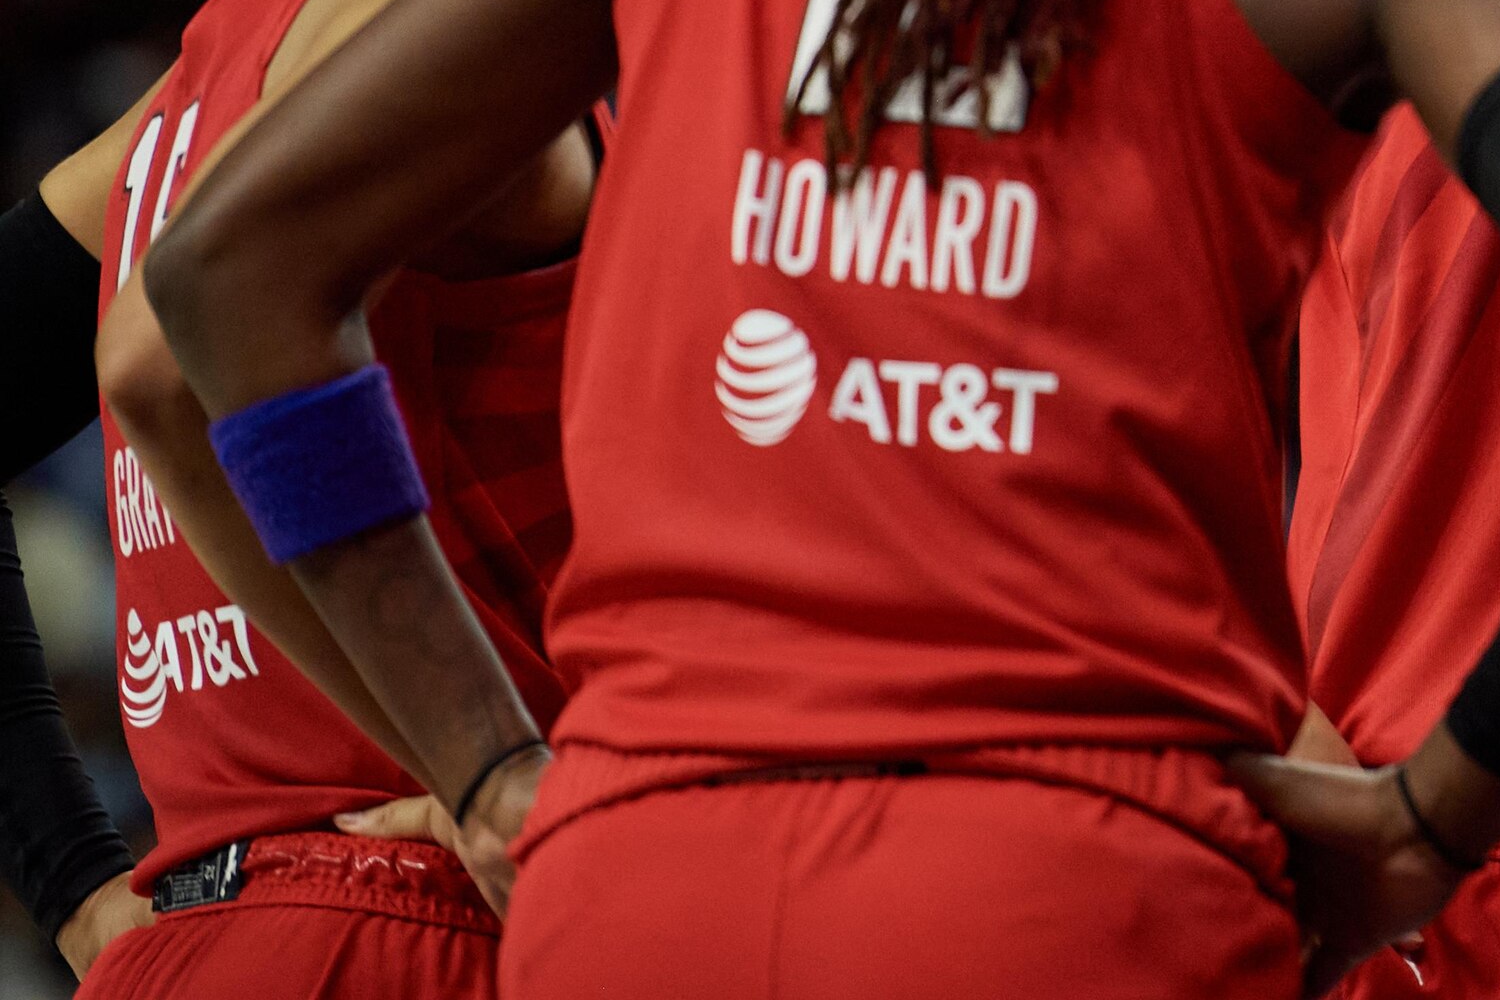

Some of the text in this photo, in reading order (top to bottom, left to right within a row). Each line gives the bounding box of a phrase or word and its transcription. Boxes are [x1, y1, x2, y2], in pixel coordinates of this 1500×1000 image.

[731, 149, 1037, 300] HOWARD
[829, 357, 1058, 455] AT&T
[155, 604, 260, 693] AT&T
